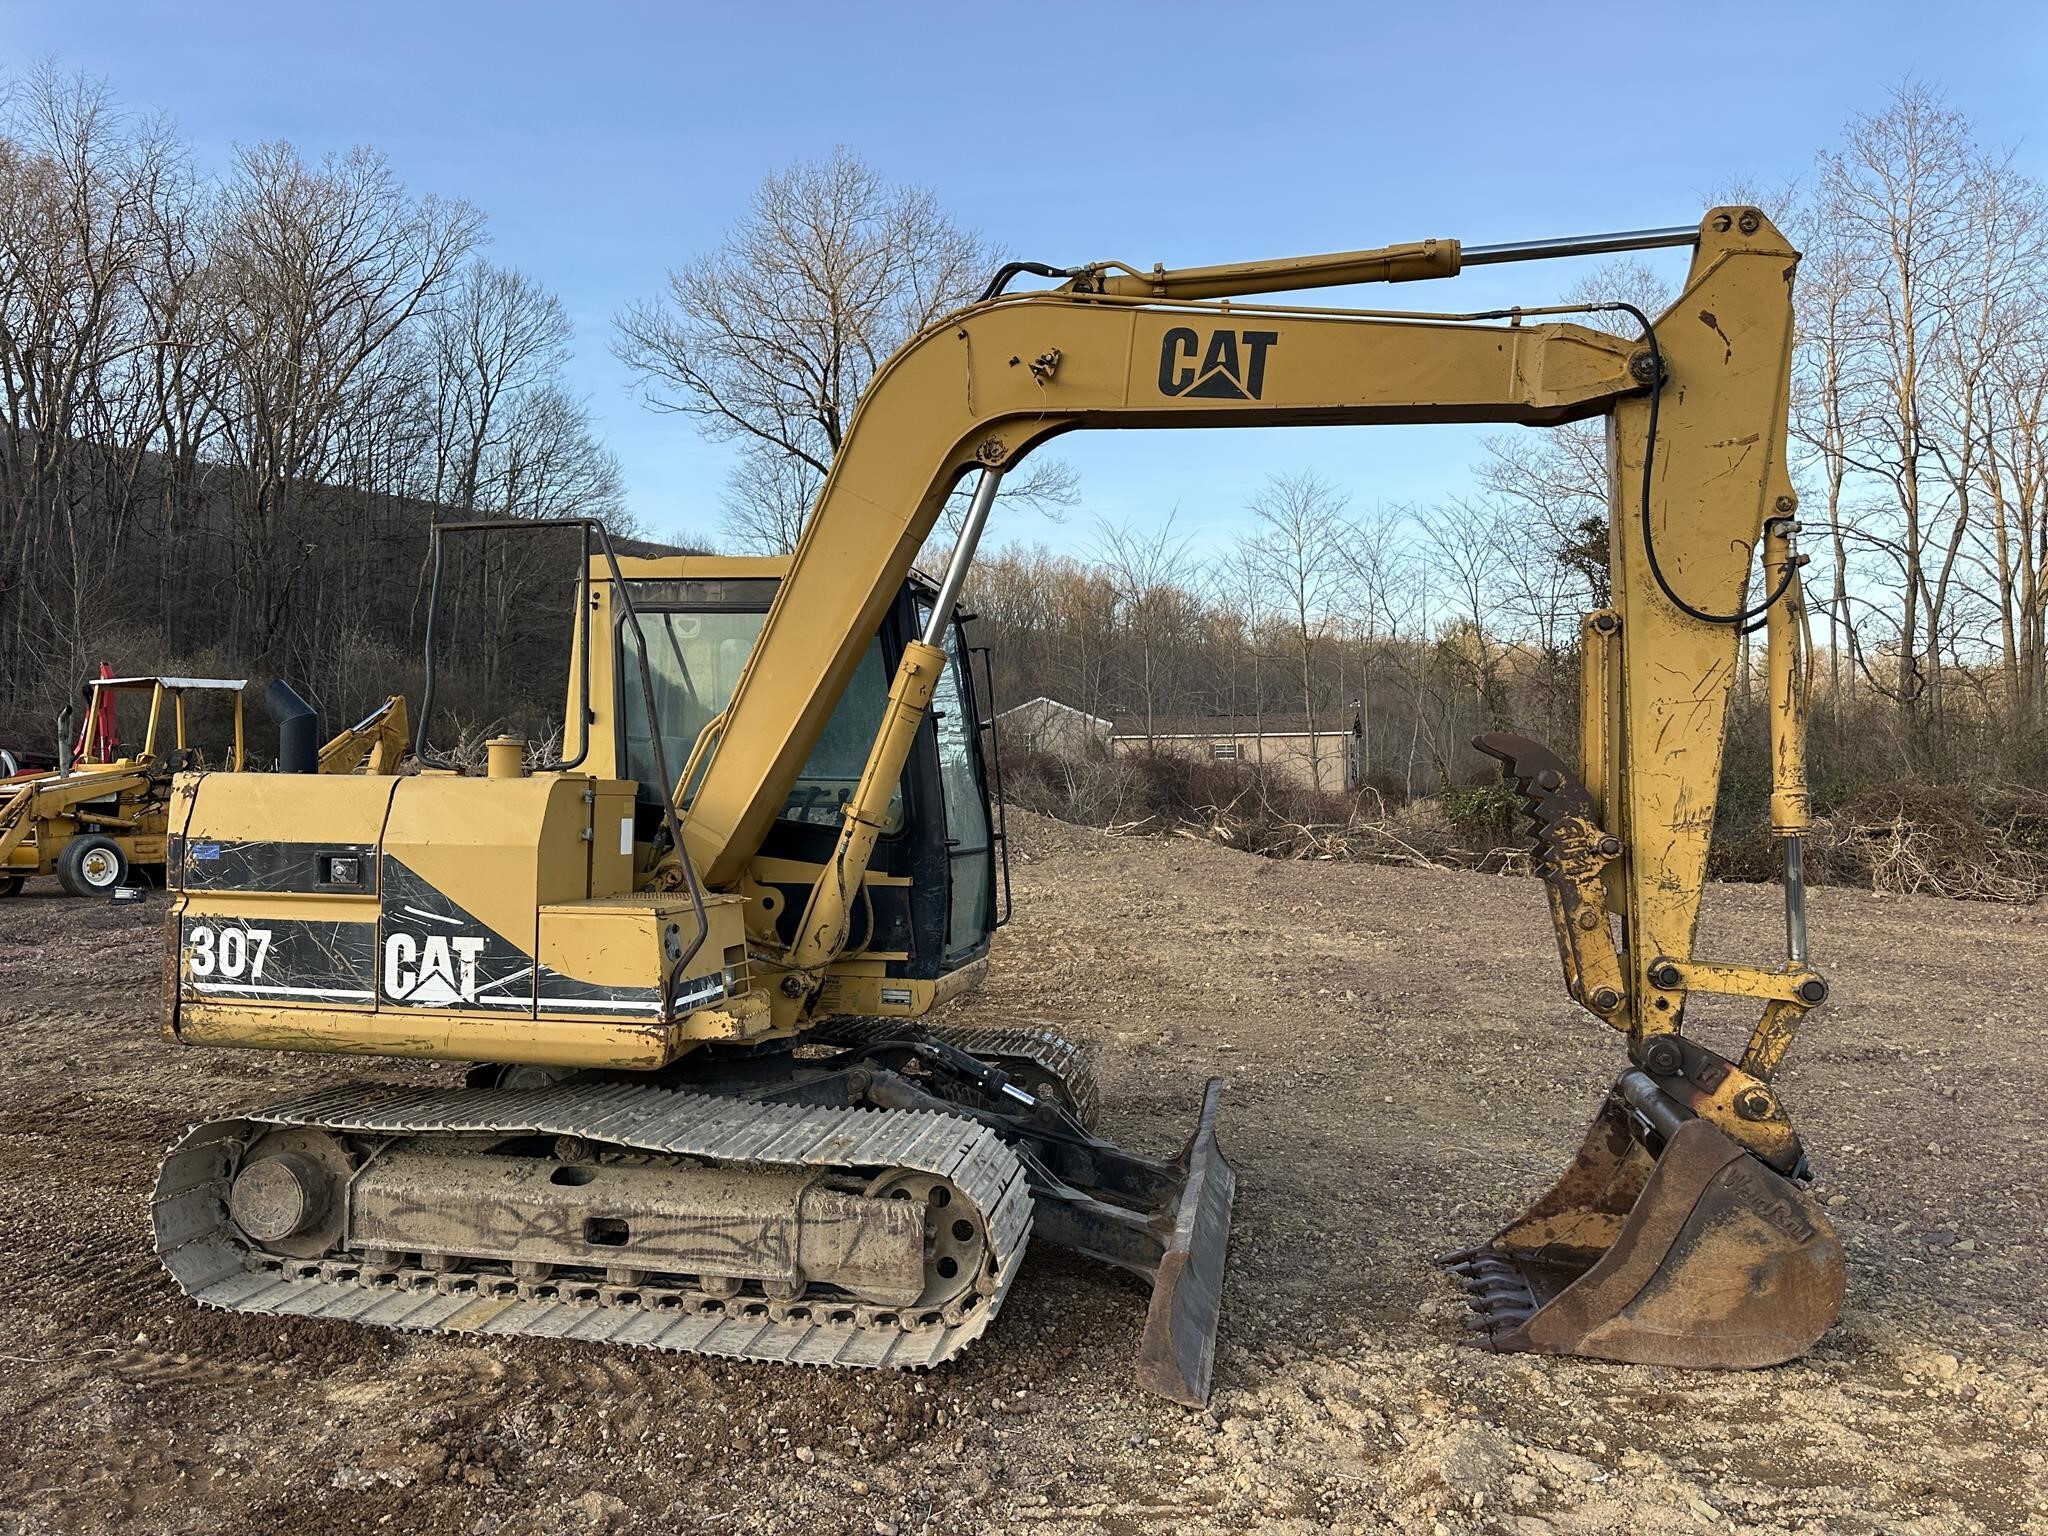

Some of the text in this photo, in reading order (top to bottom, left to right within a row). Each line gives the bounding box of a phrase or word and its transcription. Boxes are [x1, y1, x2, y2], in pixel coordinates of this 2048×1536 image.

[1158, 327, 1279, 400] CAT
[190, 926, 272, 978] 307
[385, 933, 484, 1003] CAT
